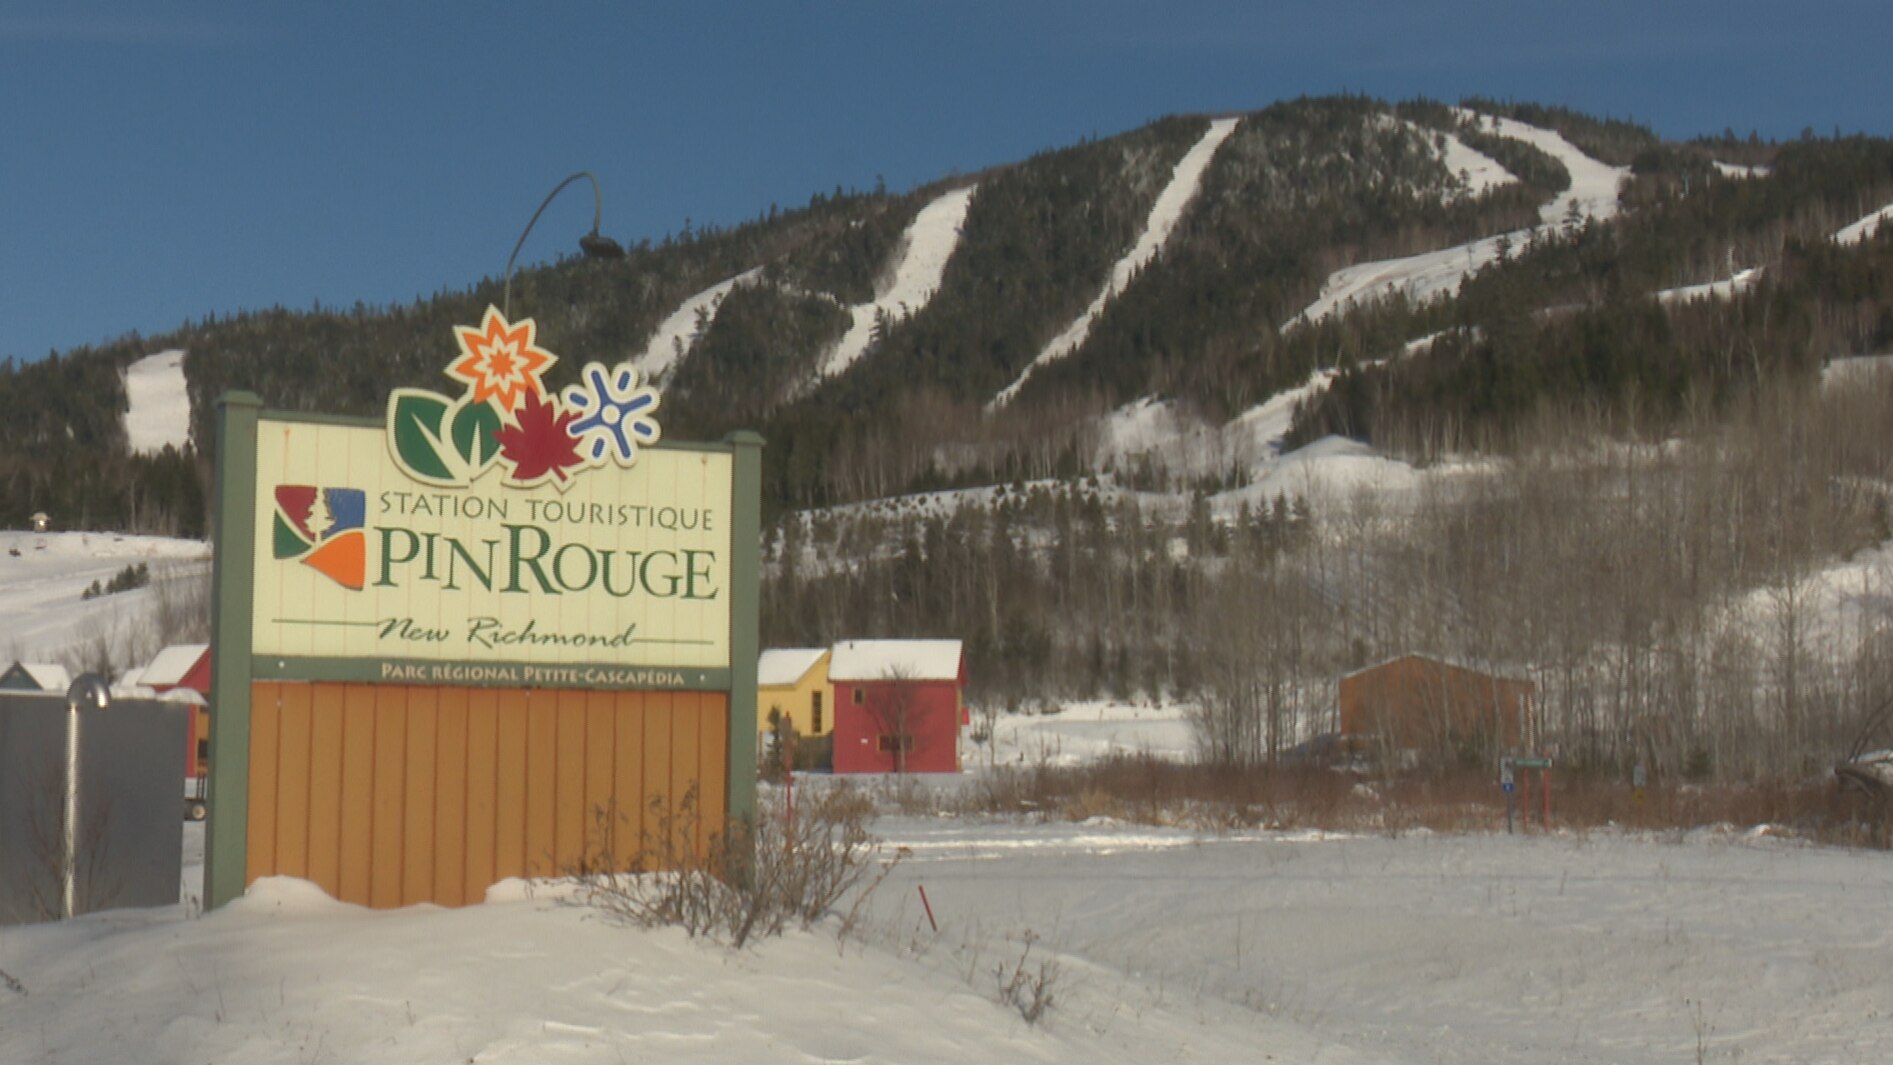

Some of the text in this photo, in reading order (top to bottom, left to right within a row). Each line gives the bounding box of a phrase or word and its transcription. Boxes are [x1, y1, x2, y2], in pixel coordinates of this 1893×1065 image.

[379, 491, 713, 530] STATION TOURISTIQUE
[378, 615, 638, 649] New Richmond
[381, 662, 685, 685] PARC RÉGIONAL PETITE-CASCAPÉDIA
